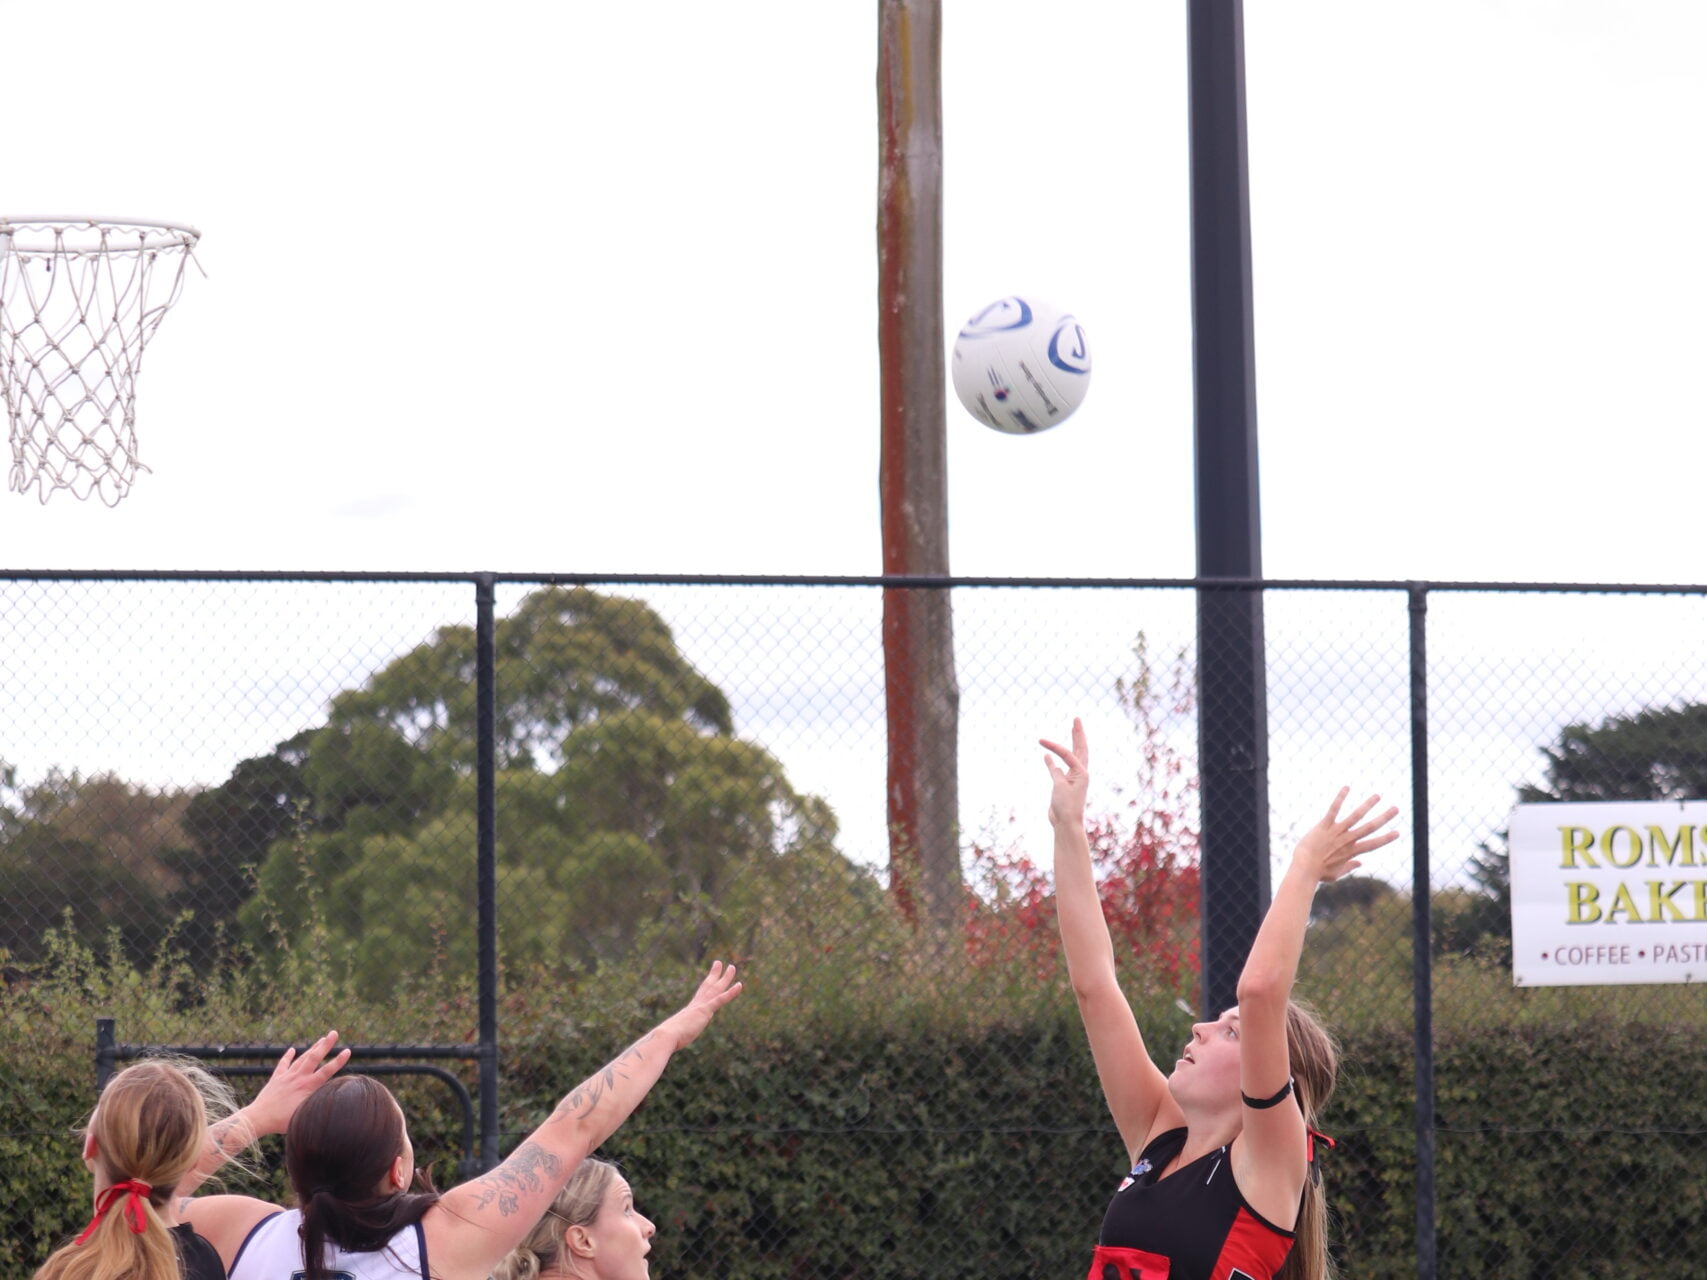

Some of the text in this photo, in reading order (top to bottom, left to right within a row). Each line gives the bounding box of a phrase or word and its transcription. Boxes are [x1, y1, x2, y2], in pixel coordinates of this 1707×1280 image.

[1557, 825, 1707, 869] ROM
[1554, 944, 1707, 966] COFFEE PAST
